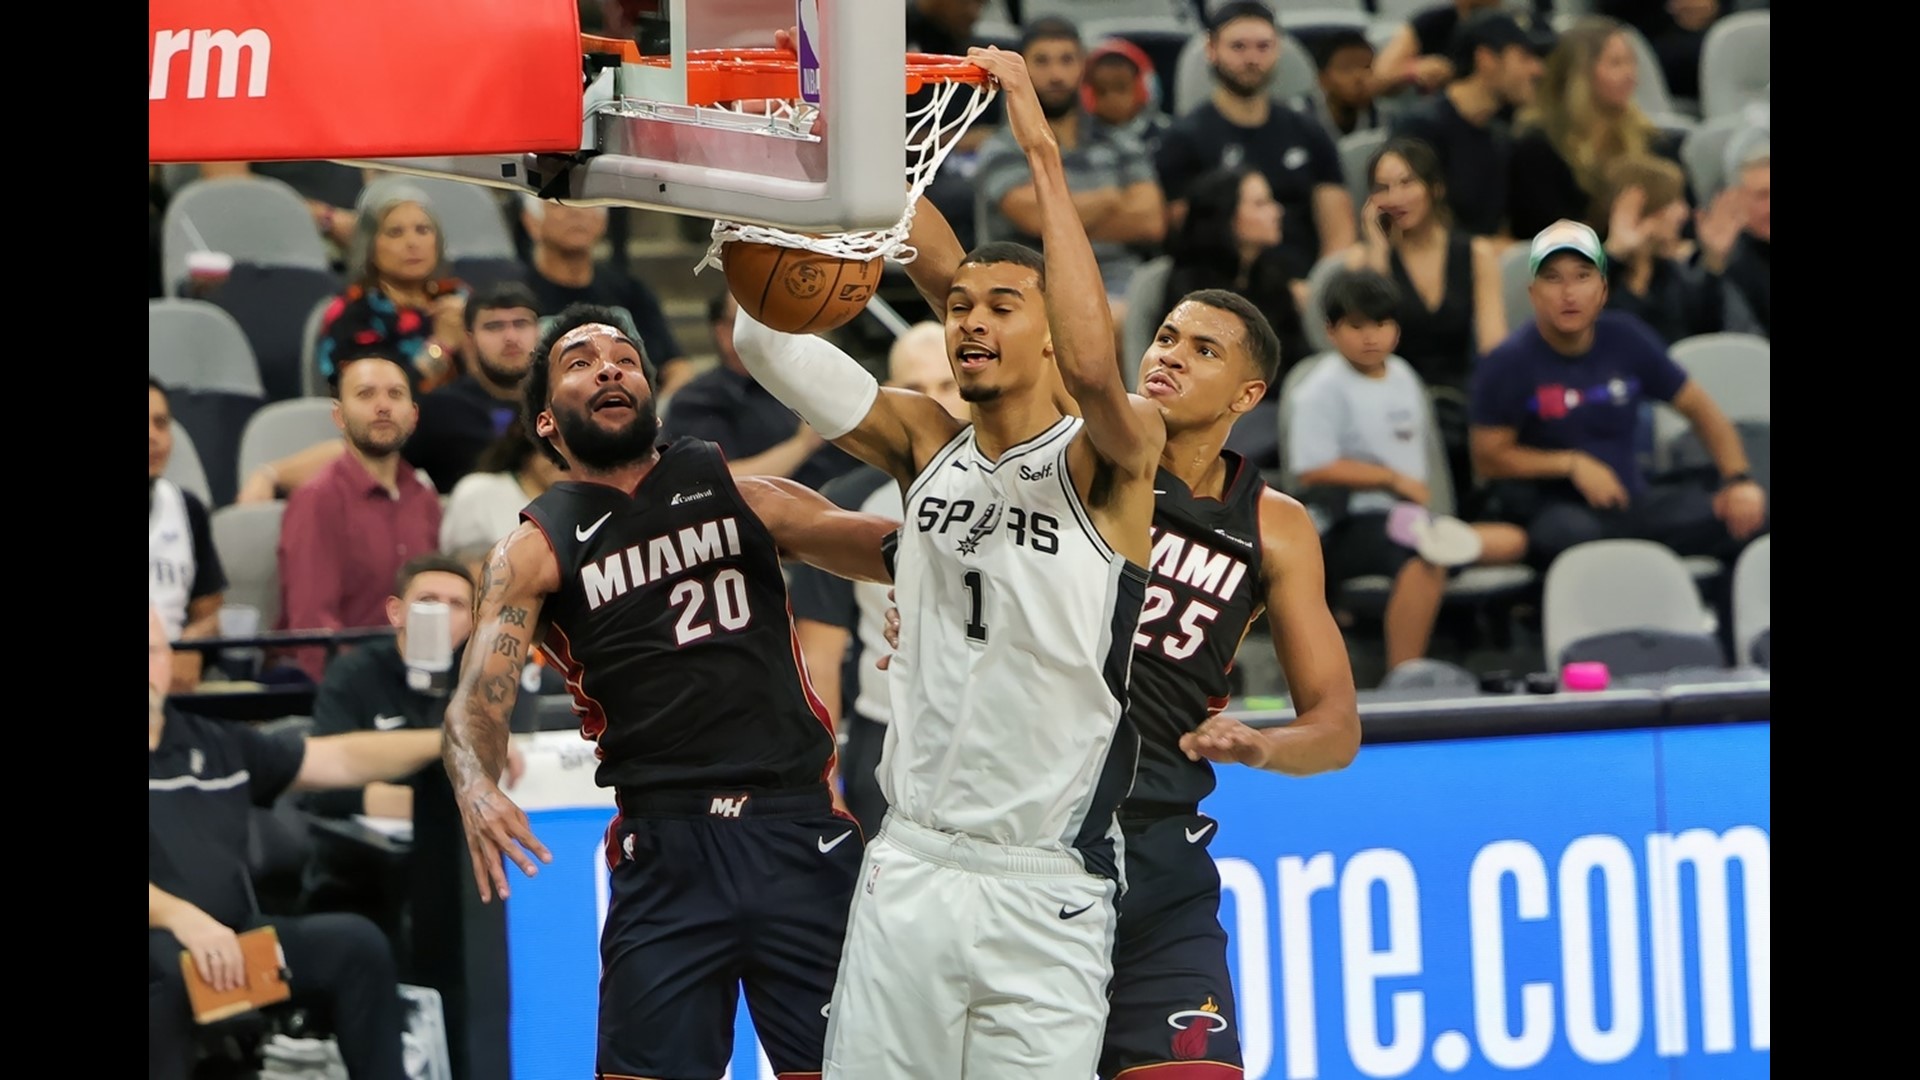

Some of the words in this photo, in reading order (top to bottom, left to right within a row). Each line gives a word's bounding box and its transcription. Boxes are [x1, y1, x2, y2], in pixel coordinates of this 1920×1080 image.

[149, 27, 272, 101] rm
[580, 517, 742, 611] MIAMI
[1147, 526, 1249, 602] AMI
[669, 567, 751, 646] 20
[962, 568, 988, 644] 1
[1132, 585, 1220, 661] 25
